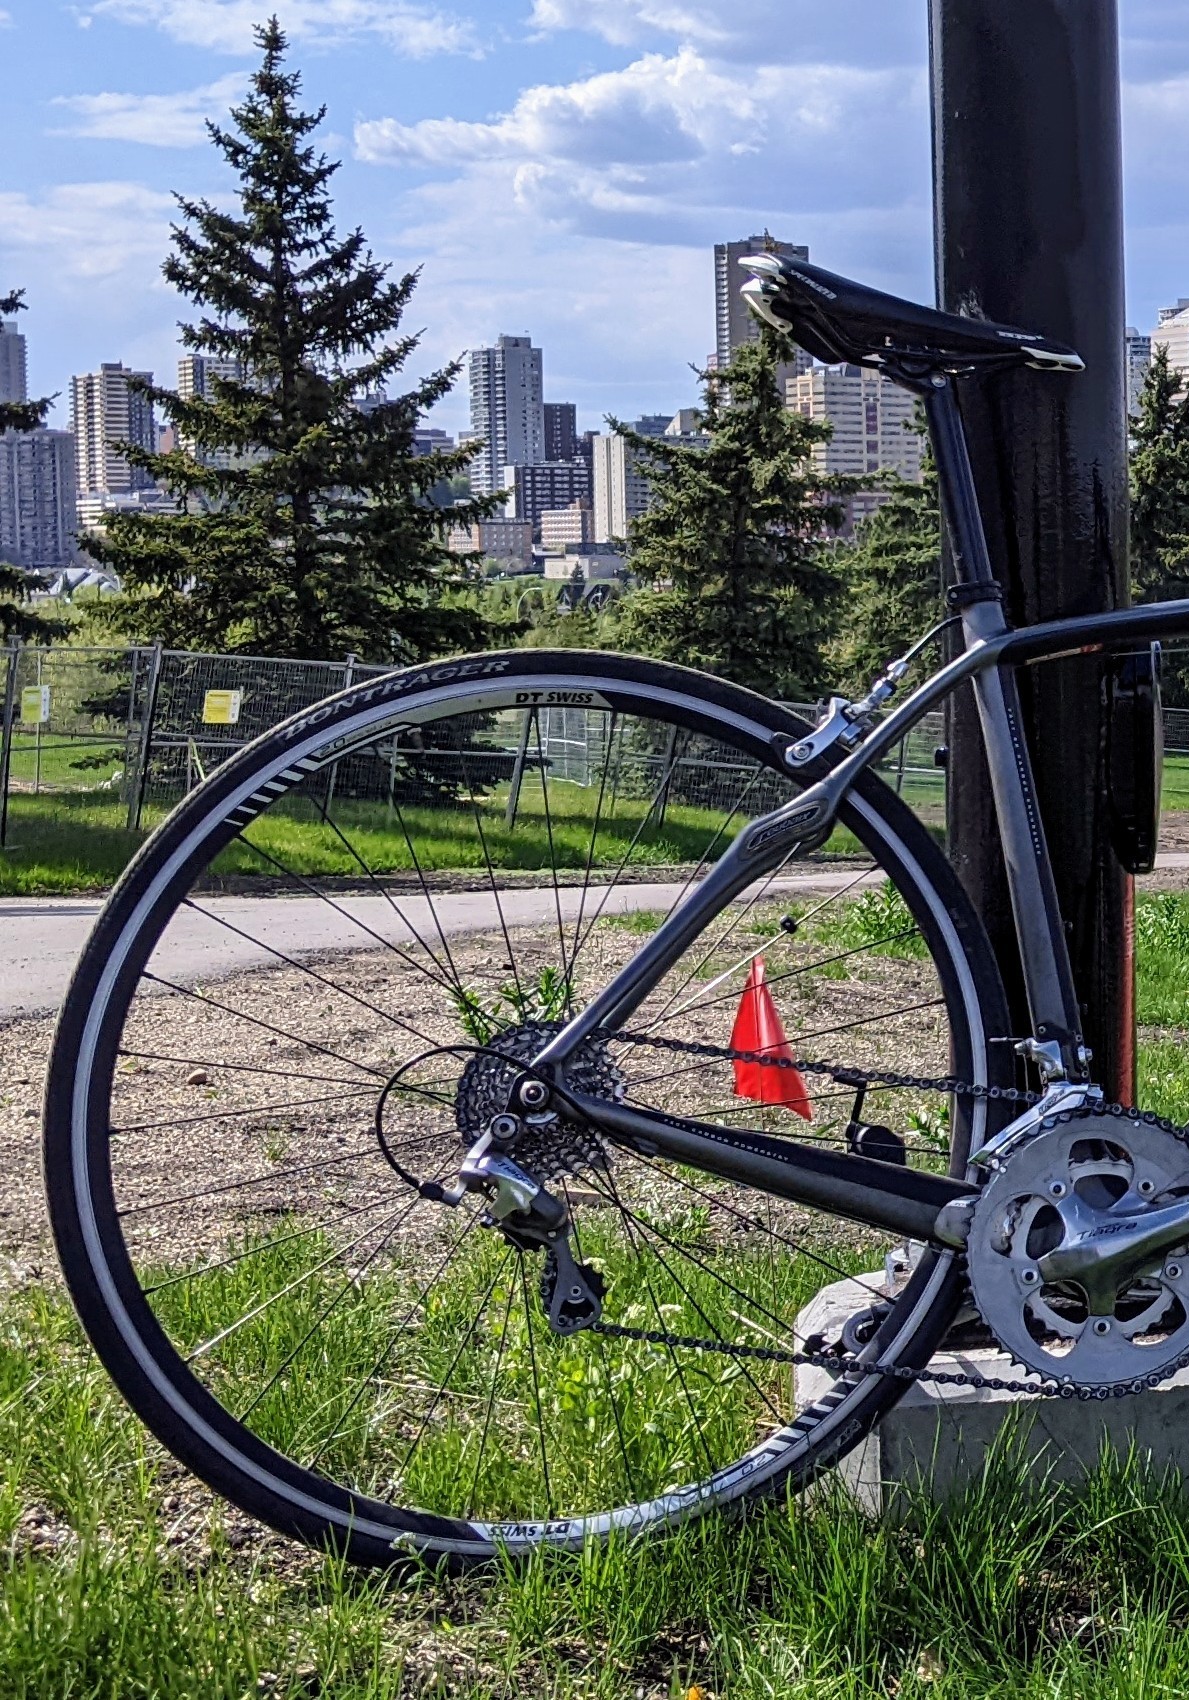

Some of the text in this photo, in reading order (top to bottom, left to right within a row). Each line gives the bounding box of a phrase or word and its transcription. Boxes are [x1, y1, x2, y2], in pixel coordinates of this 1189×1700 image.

[284, 660, 511, 740] BONTRAGER
[515, 691, 594, 704] DT SWISS
[1077, 1222, 1138, 1240] Tiagra
